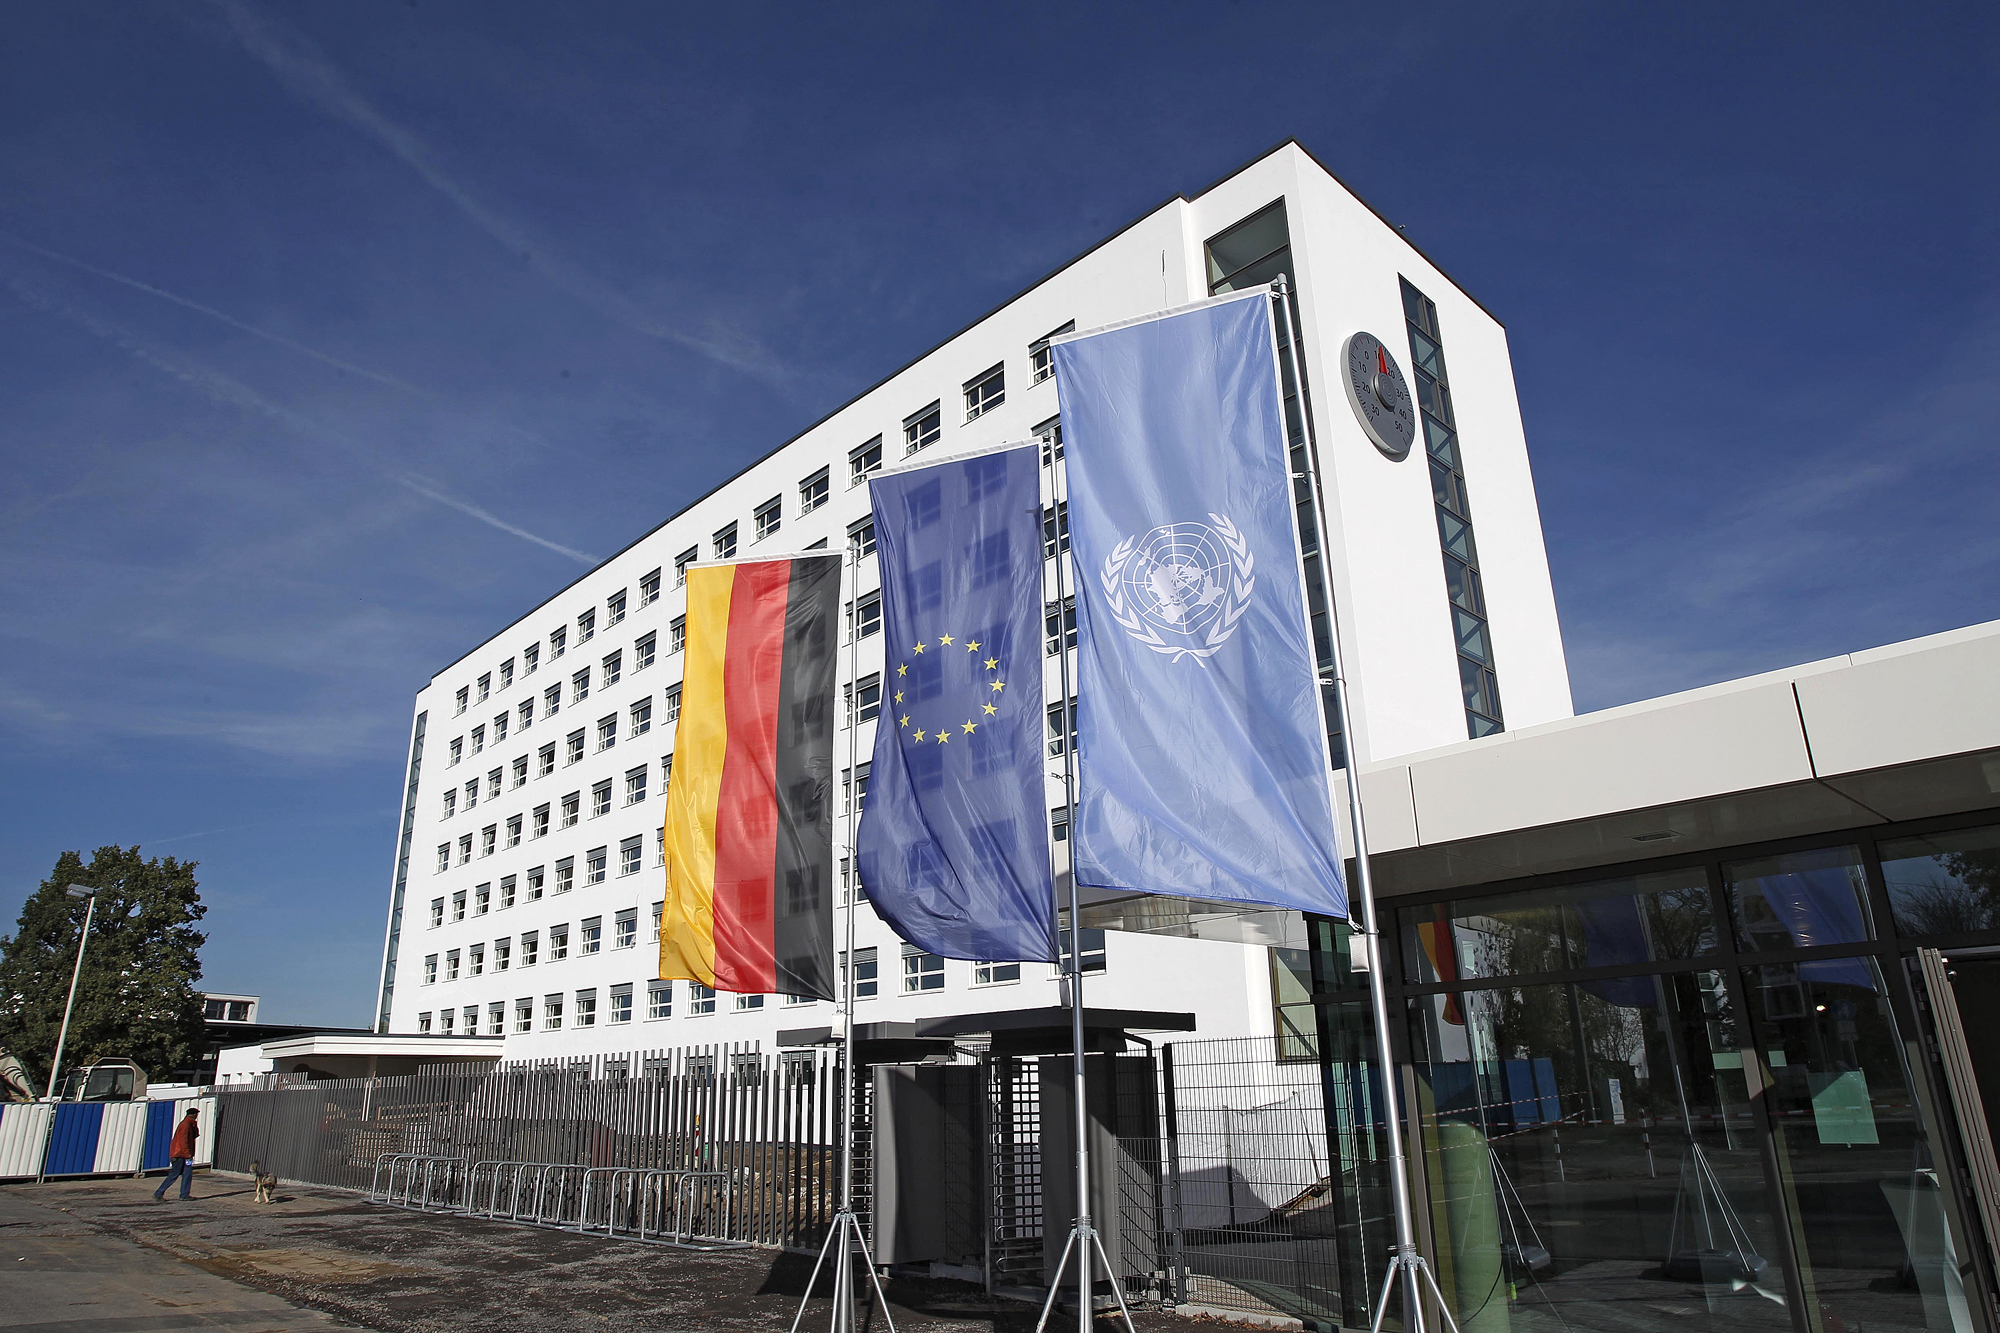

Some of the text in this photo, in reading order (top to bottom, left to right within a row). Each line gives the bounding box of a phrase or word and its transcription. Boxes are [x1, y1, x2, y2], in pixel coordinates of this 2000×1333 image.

[1364, 350, 1369, 360] 0
[1358, 361, 1366, 373] 10
[1387, 367, 1395, 379] 20
[1362, 382, 1370, 394] 20
[1396, 388, 1404, 400] 30
[1371, 403, 1379, 416] 30
[1399, 409, 1407, 420] 40
[1395, 420, 1403, 432] 50
